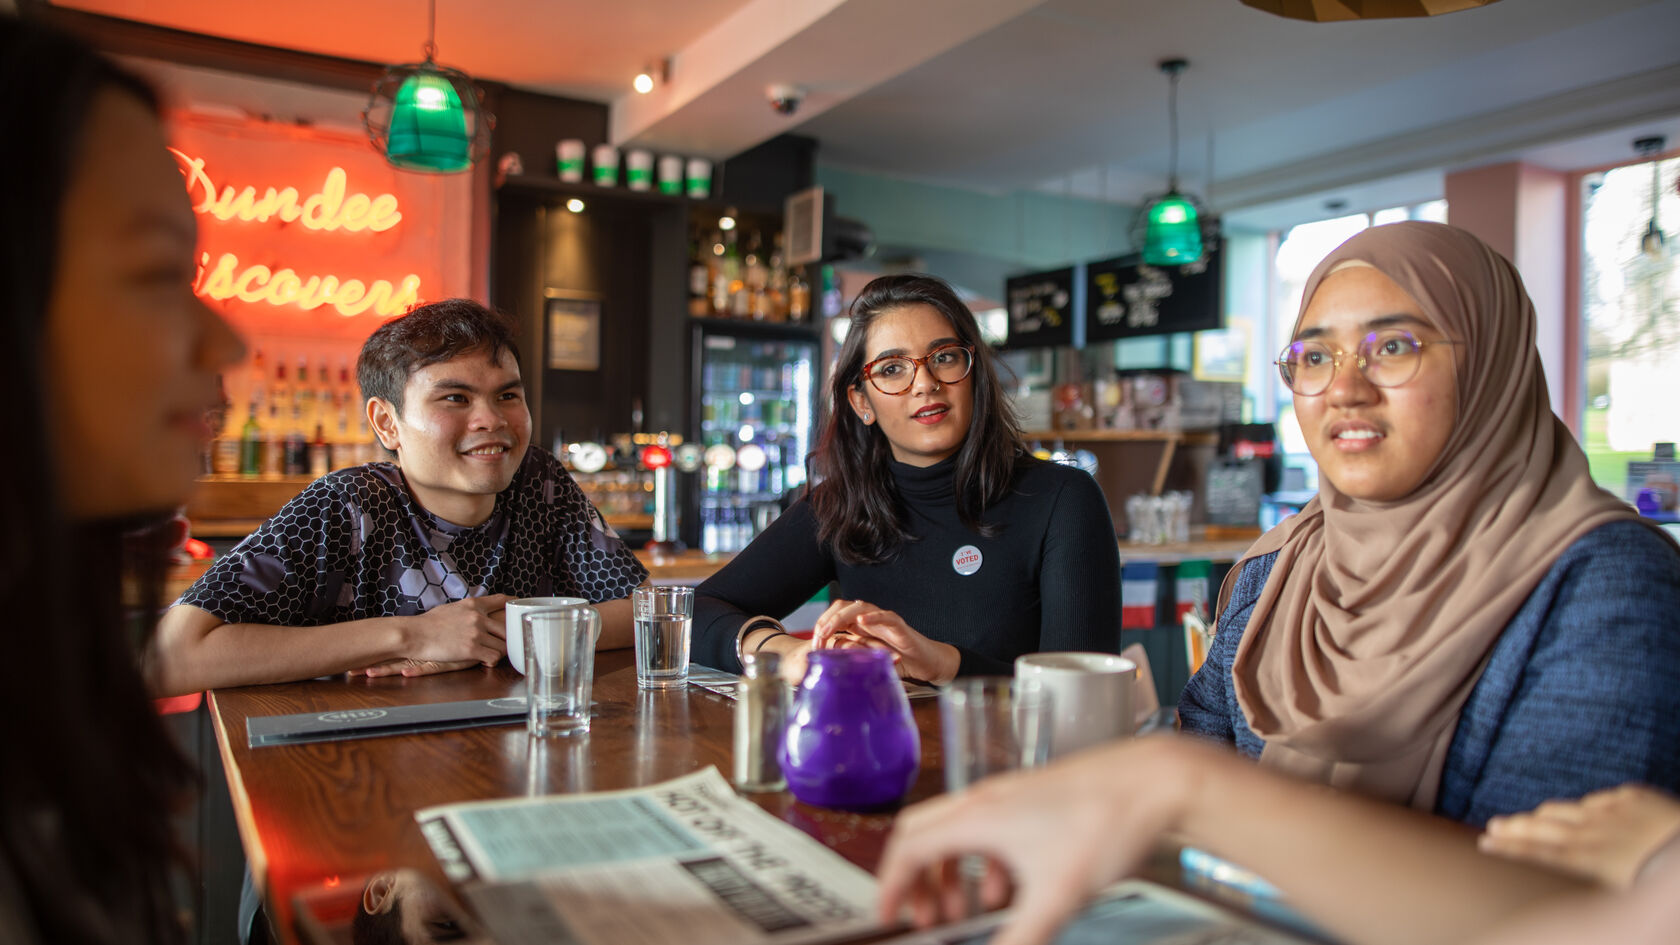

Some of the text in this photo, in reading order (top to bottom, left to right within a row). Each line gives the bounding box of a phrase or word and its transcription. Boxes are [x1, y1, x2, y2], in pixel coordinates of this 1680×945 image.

[167, 146, 402, 232] Dundee
[191, 252, 421, 317] iscovers
[956, 554, 979, 566] VOTED
